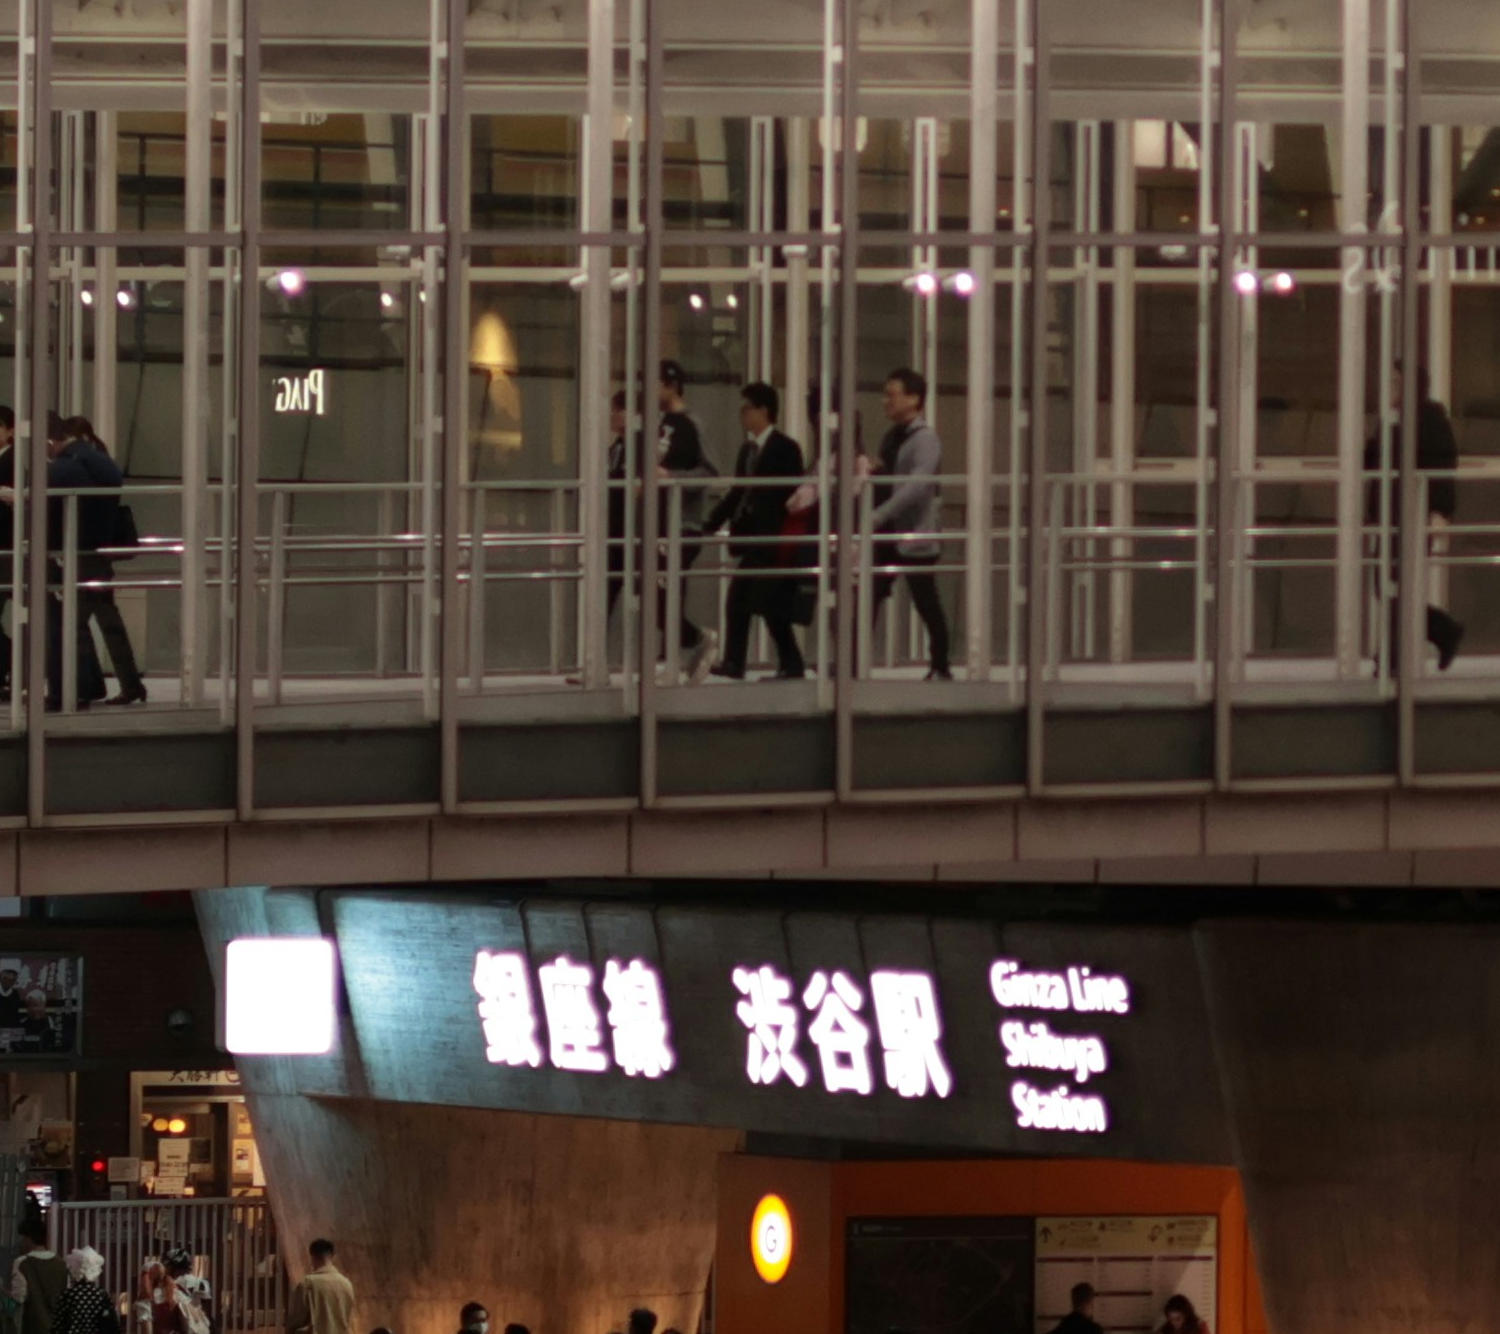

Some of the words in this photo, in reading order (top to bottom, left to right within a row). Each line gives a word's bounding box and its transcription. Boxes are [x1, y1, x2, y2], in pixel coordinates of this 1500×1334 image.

[990, 961, 1068, 1010] Ginza
[1068, 967, 1129, 1013] Line
[473, 948, 674, 1078] 銀座線
[732, 965, 951, 1098] 渋谷駅
[1000, 1022, 1106, 1083] Shibuya
[1011, 1082, 1106, 1132] Station
